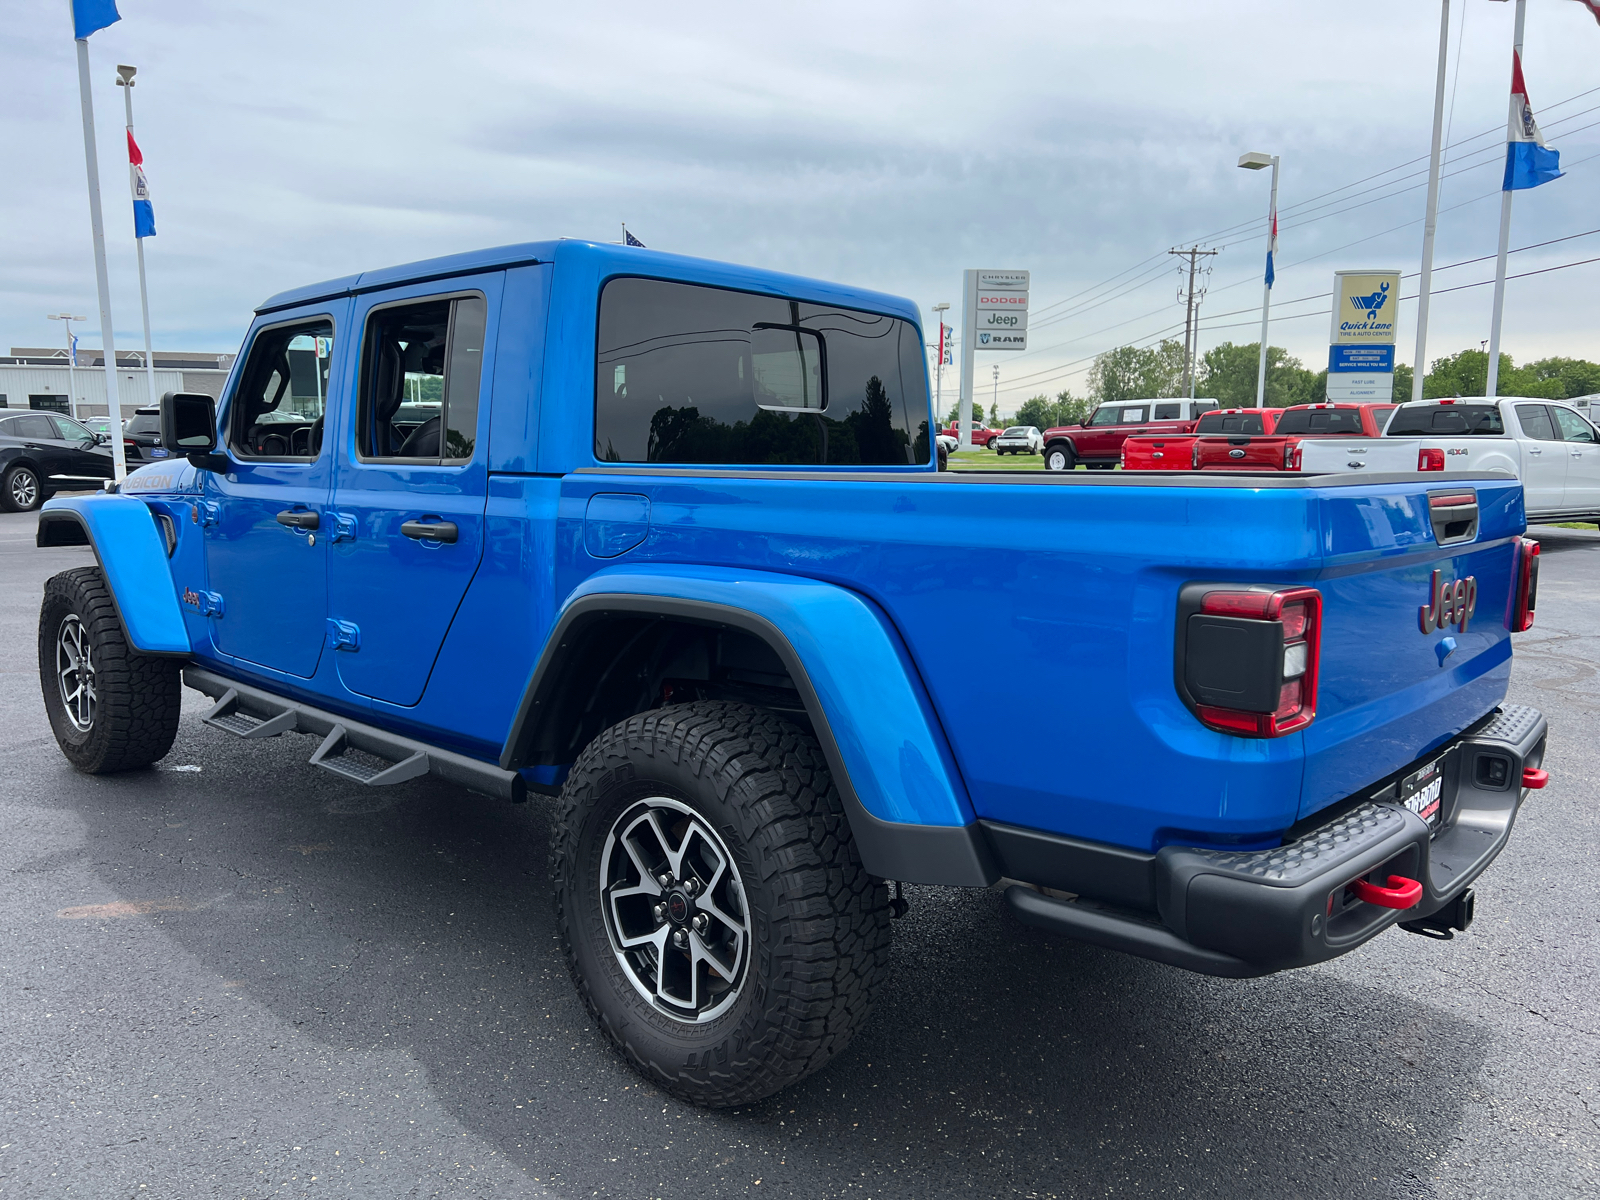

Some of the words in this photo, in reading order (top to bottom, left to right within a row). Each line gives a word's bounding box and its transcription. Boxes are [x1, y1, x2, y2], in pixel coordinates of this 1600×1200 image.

[987, 313, 1018, 327] Jeep
[1340, 321, 1368, 330] Quick
[1369, 321, 1392, 330] Lane
[122, 474, 174, 490] RUBICON
[1420, 569, 1477, 635] Jeep
